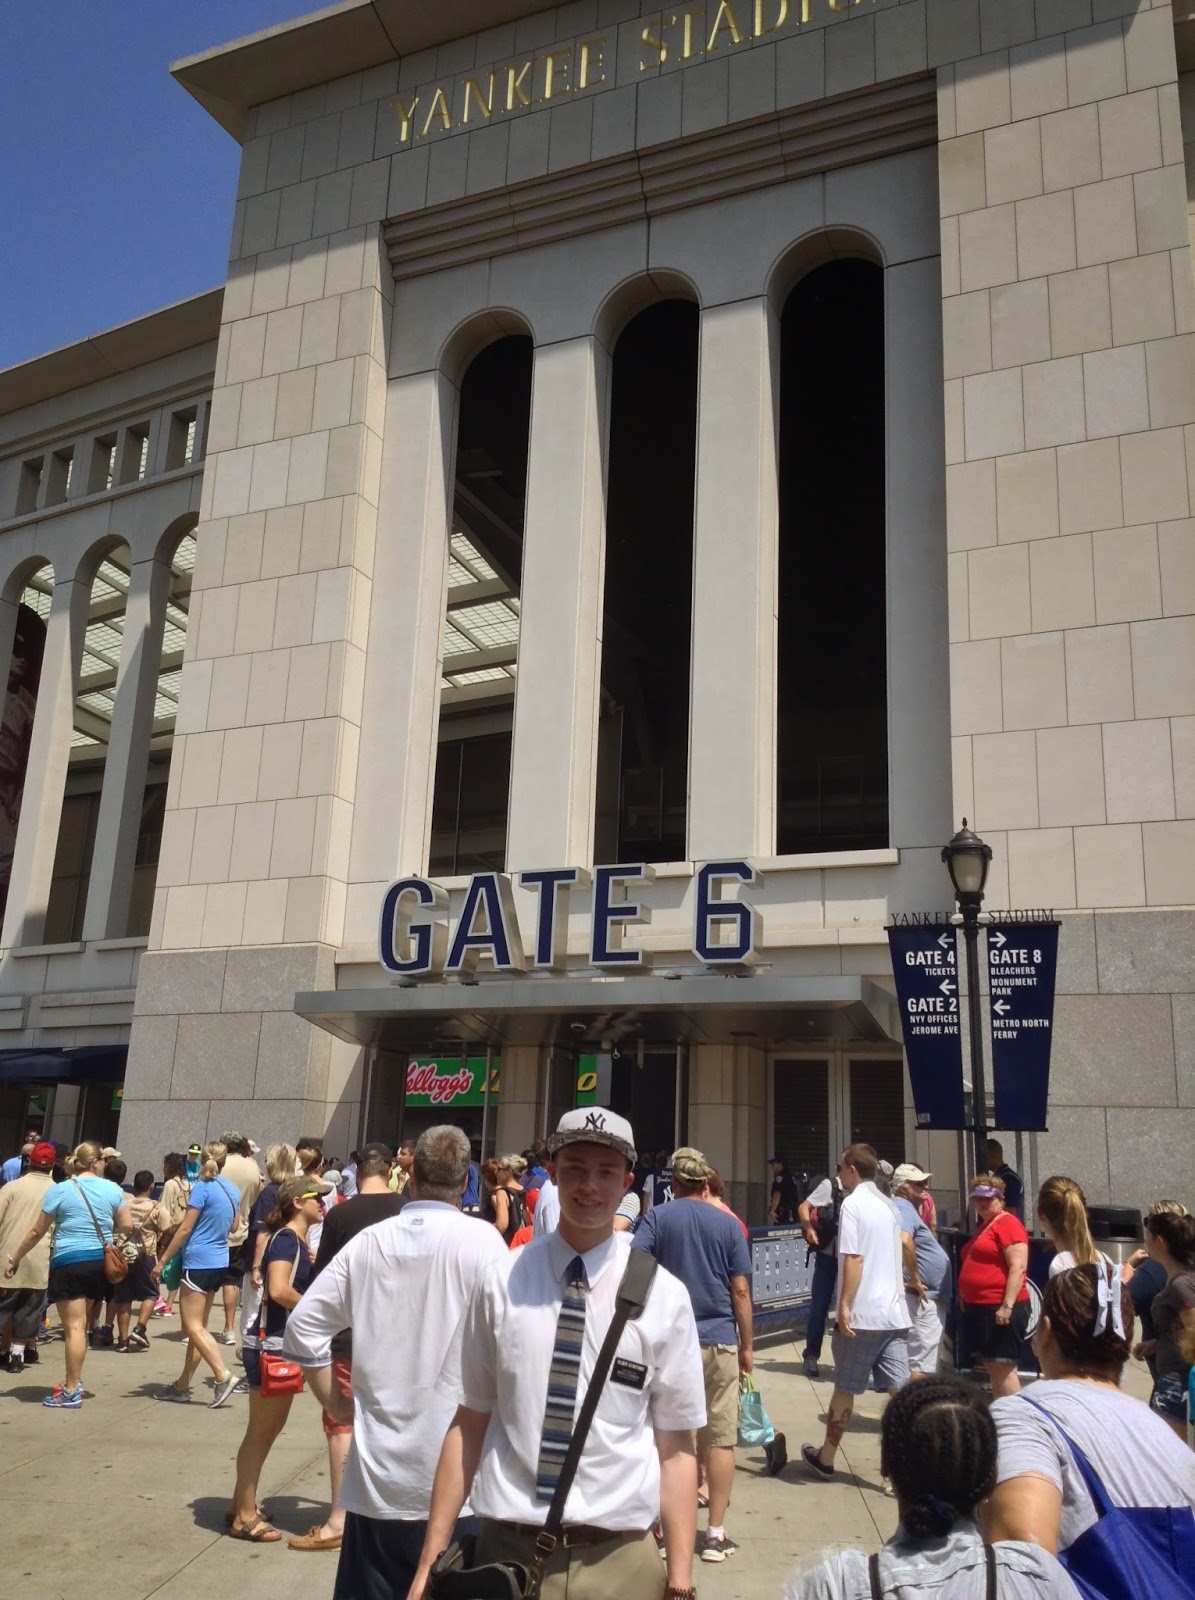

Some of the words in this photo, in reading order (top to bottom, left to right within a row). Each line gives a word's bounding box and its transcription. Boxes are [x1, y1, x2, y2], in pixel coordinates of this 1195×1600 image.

[390, 36, 607, 145] YANKEE
[378, 862, 653, 976] GATE
[690, 858, 764, 967] 6
[988, 908, 1055, 924] STADIUM
[905, 951, 943, 966] GATE
[946, 950, 956, 965] 4
[989, 950, 1029, 965] GATE
[1032, 949, 1042, 964] 8
[924, 967, 956, 976] TICKETS
[990, 966, 1036, 976] BLEACHERS
[991, 977, 1038, 987] MONUMENT
[991, 987, 1012, 996] PARK
[907, 997, 945, 1013] GATE
[948, 997, 958, 1012] 2
[909, 1015, 925, 1024] NYY
[927, 1014, 958, 1023] OFFICES
[992, 1019, 1020, 1028] METRO
[1022, 1018, 1049, 1028] NORTH
[911, 1026, 942, 1035] JEROME
[943, 1025, 959, 1034] AVE
[993, 1030, 1018, 1040] FERRY
[584, 1112, 606, 1131] NY
